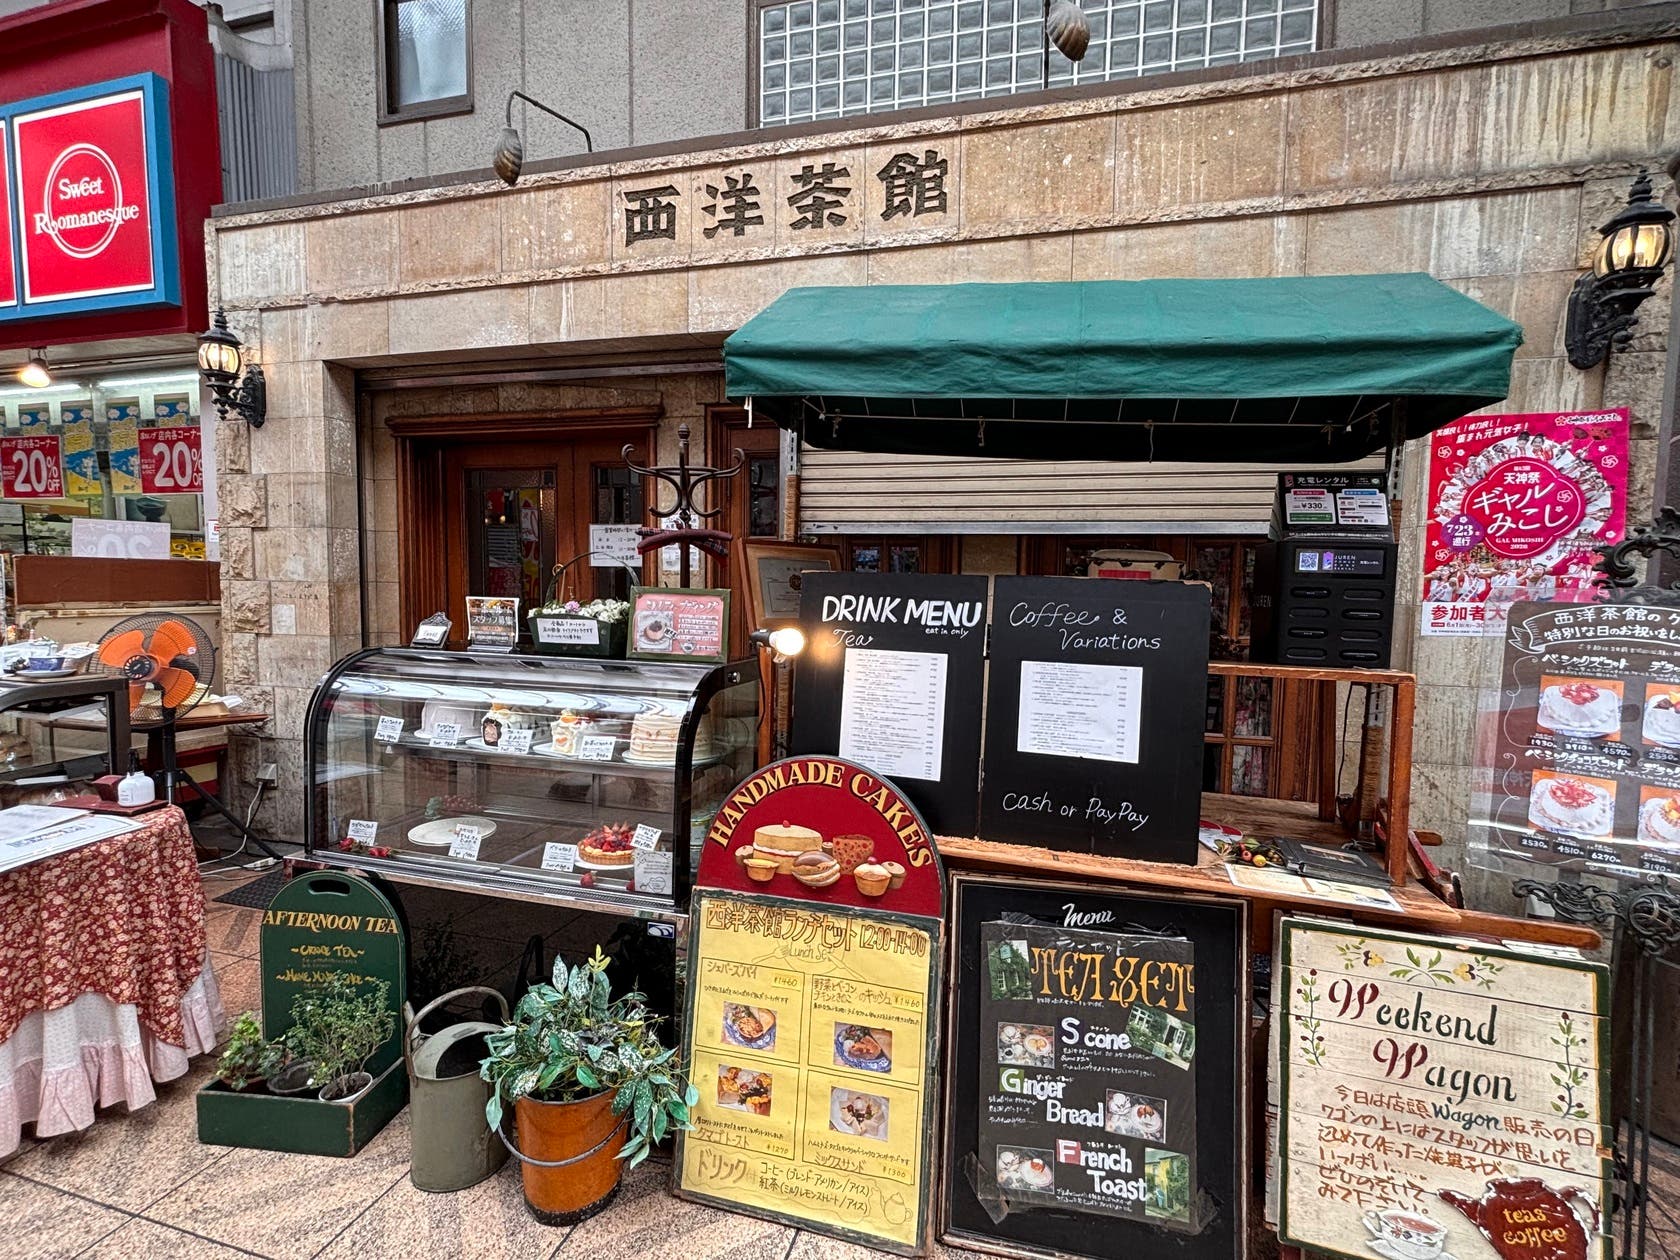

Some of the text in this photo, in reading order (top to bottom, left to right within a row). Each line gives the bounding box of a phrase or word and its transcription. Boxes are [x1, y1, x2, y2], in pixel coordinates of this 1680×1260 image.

[58, 177, 105, 200] Sweet
[623, 149, 949, 248] 西洋茶館
[33, 204, 140, 235] Romanesque
[47, 479, 60, 492] OFF
[1297, 476, 1350, 484] 充電レンタル
[1503, 472, 1540, 485] 天神祭
[1301, 502, 1323, 510] ¥330
[1472, 482, 1555, 516] ギャル
[1486, 507, 1569, 537] みこし
[822, 594, 983, 627] DRINK MENU
[1009, 602, 1128, 628] Coffee &
[832, 628, 874, 648] Tea
[925, 627, 939, 635] eat
[950, 628, 969, 639] only
[1059, 628, 1161, 650] Variations
[709, 761, 934, 868] HANDMADE CAKES
[1002, 791, 1150, 831] Cash or PayPay
[262, 910, 399, 934] AFTERNOON TEA
[706, 899, 858, 952] 西洋茶館ランチセット
[1062, 903, 1117, 928] Menu
[788, 943, 814, 960] Lunch
[1031, 947, 1196, 1013] TEA SET
[1328, 978, 1499, 1047] Weekend
[1001, 1068, 1067, 1101] Ginger
[1372, 1038, 1518, 1107] Wagon
[1046, 1099, 1105, 1128] Bread
[1058, 1139, 1133, 1174] French
[1086, 1169, 1149, 1202] Toast
[1503, 1207, 1547, 1224] teas
[1503, 1226, 1568, 1248] coffee
